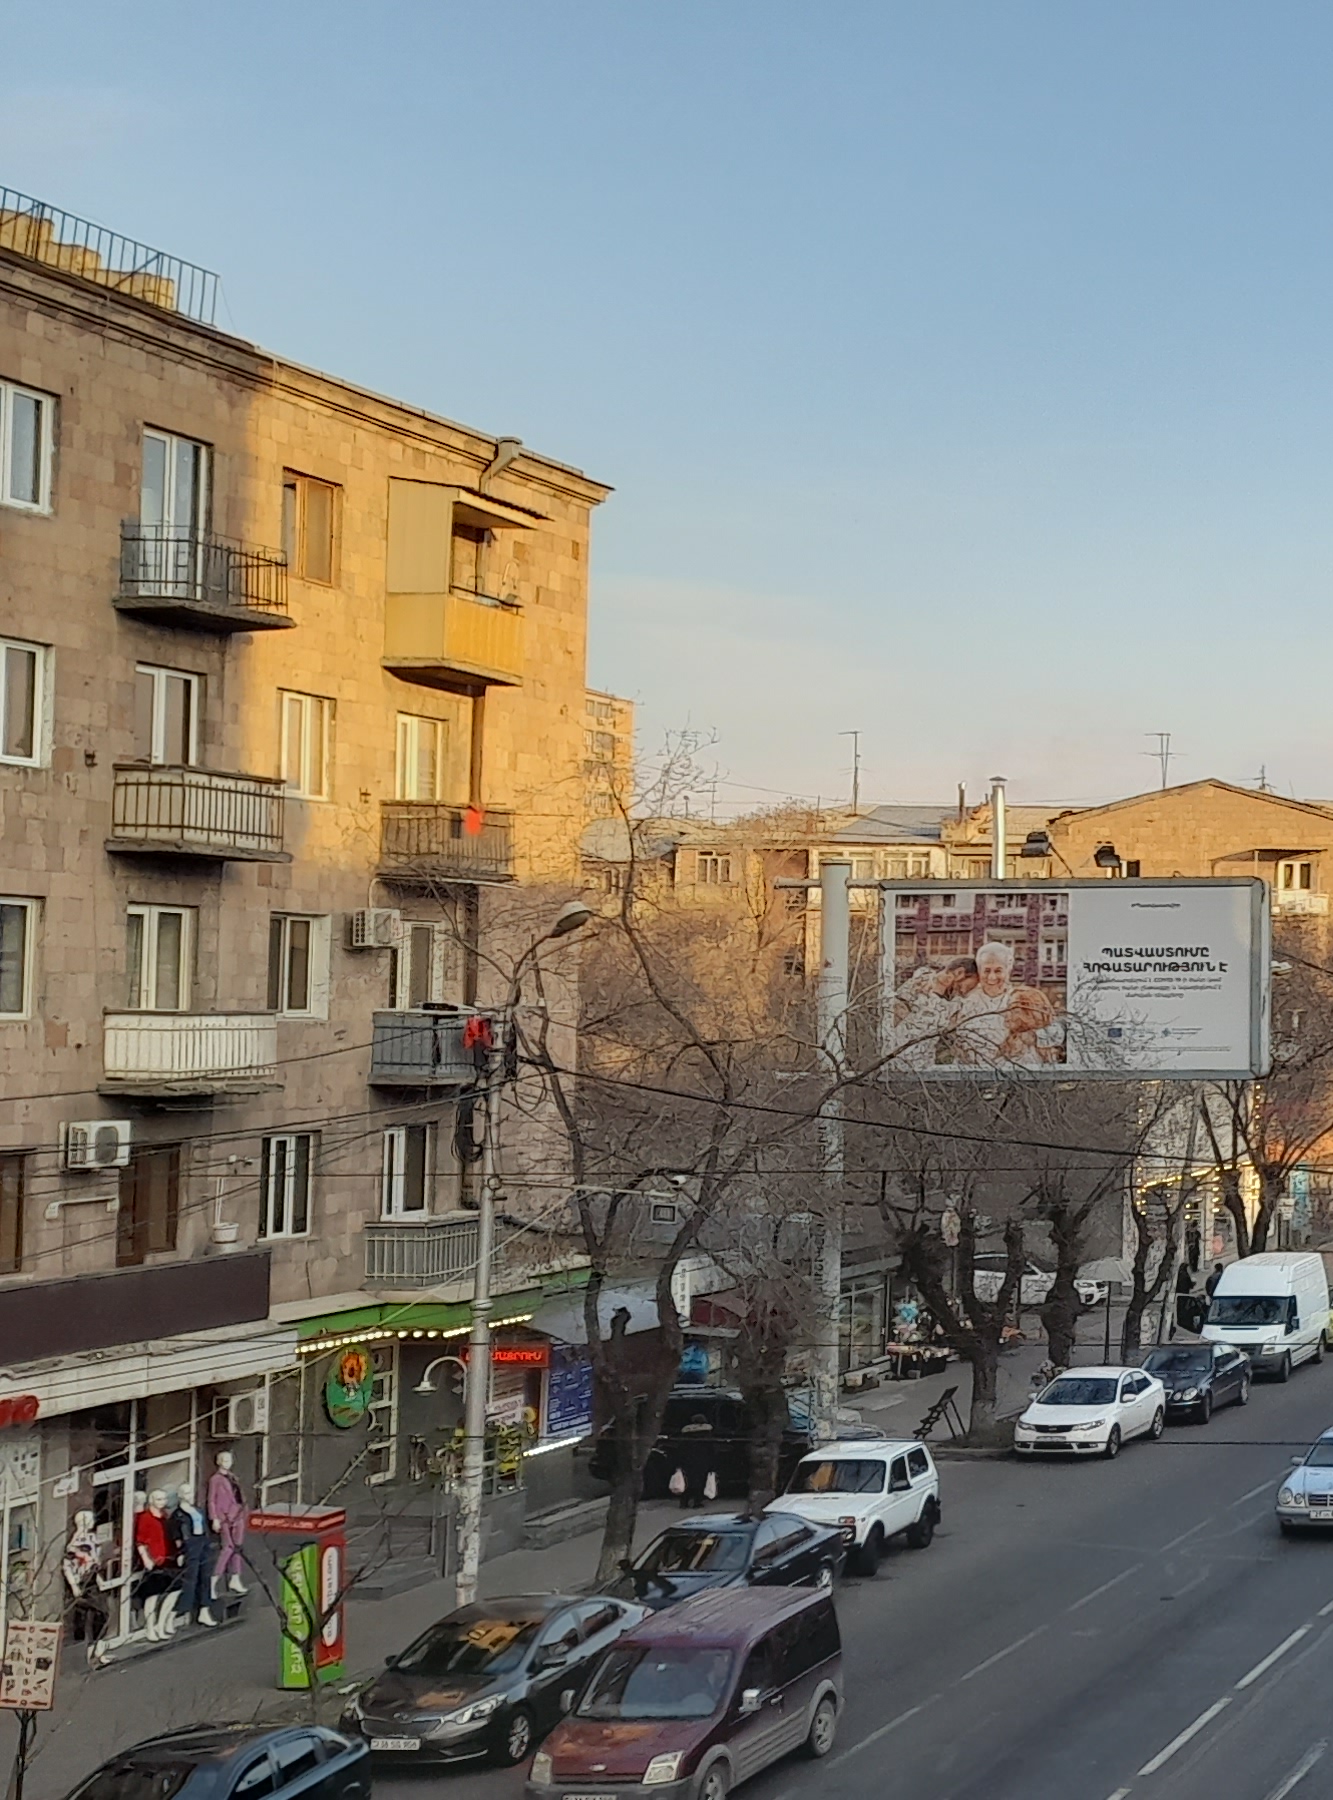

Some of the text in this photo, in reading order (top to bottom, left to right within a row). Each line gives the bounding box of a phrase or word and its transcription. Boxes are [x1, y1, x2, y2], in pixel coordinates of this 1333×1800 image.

[1101, 947, 1210, 958] ՊԱՏՎԱՍՏՈՒՄԸ
[1083, 962, 1229, 973] ՀՈԳԱՏԱՐՈՒԹՅՈՒՆ Է
